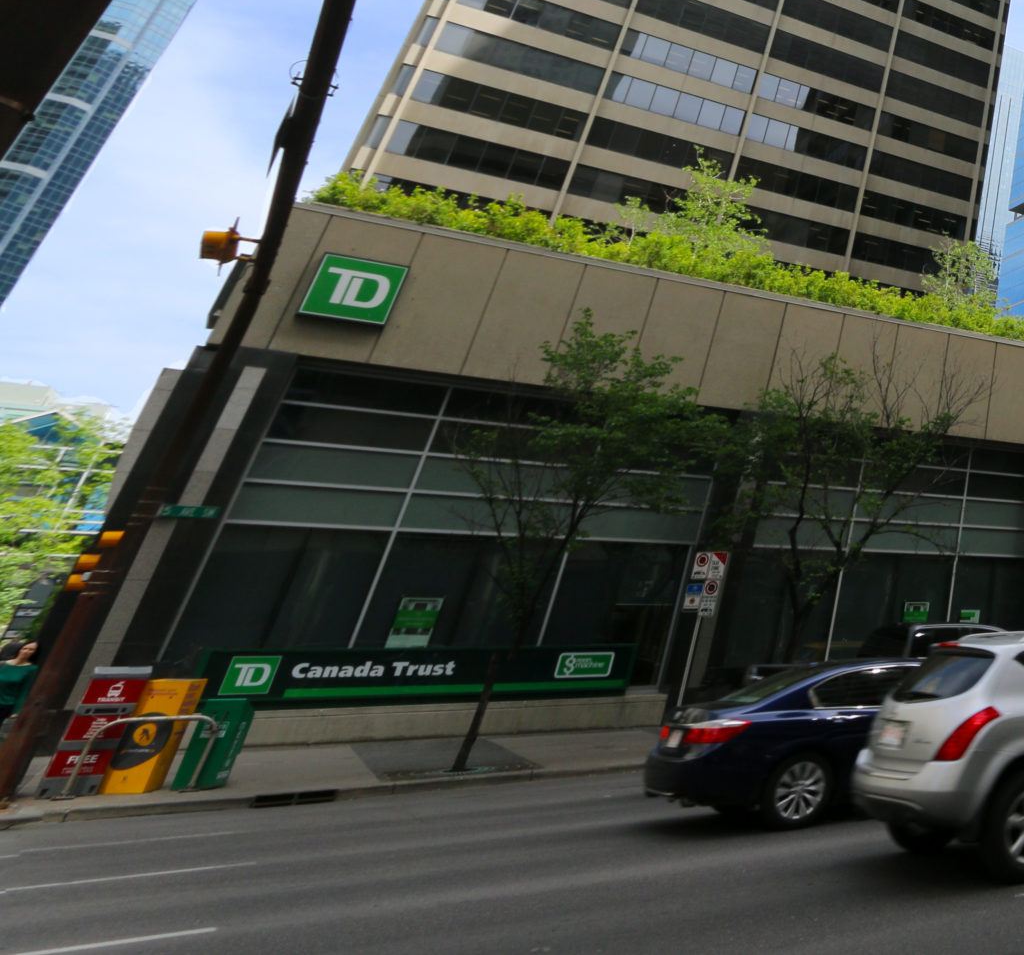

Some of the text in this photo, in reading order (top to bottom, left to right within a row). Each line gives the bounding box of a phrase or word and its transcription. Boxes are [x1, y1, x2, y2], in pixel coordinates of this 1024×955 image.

[327, 266, 391, 309] TD
[234, 660, 456, 687] TD Canada Trust
